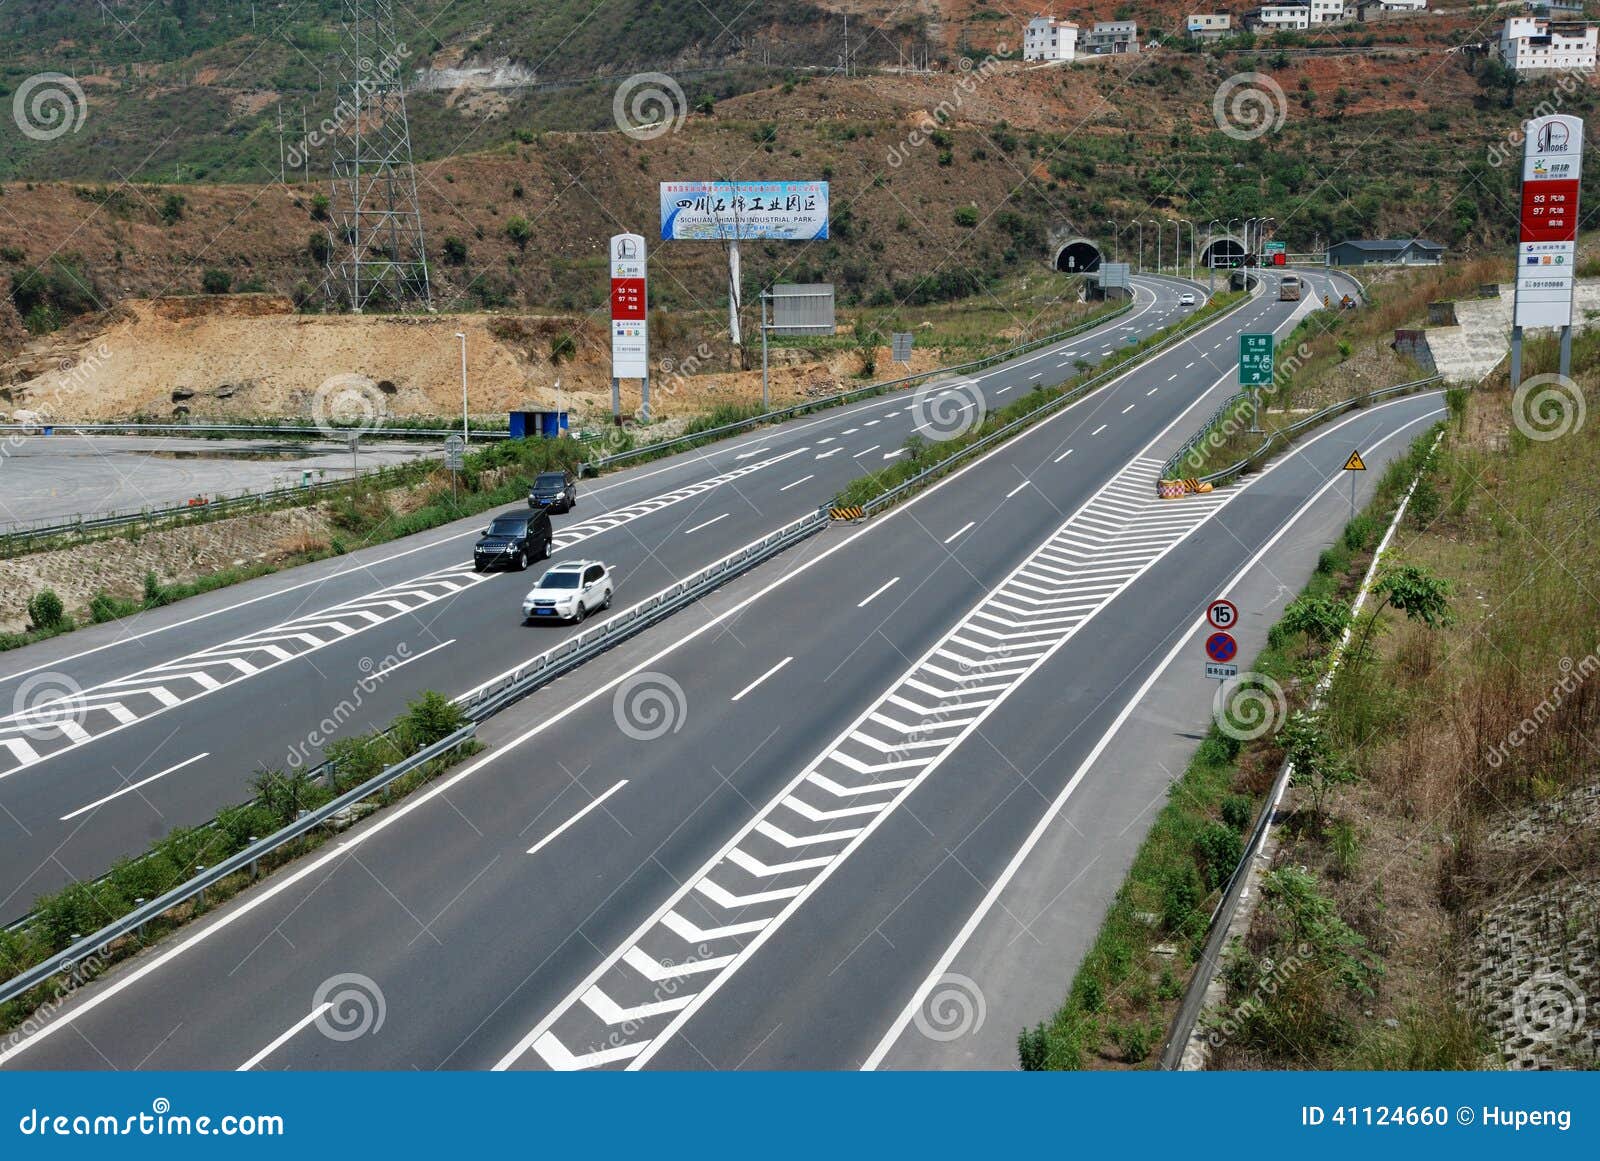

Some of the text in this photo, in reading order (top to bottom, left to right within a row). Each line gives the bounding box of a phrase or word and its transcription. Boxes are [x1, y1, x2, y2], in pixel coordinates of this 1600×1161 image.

[1533, 195, 1545, 203] 93
[1533, 207, 1544, 215] 97
[1213, 606, 1231, 623] 15
